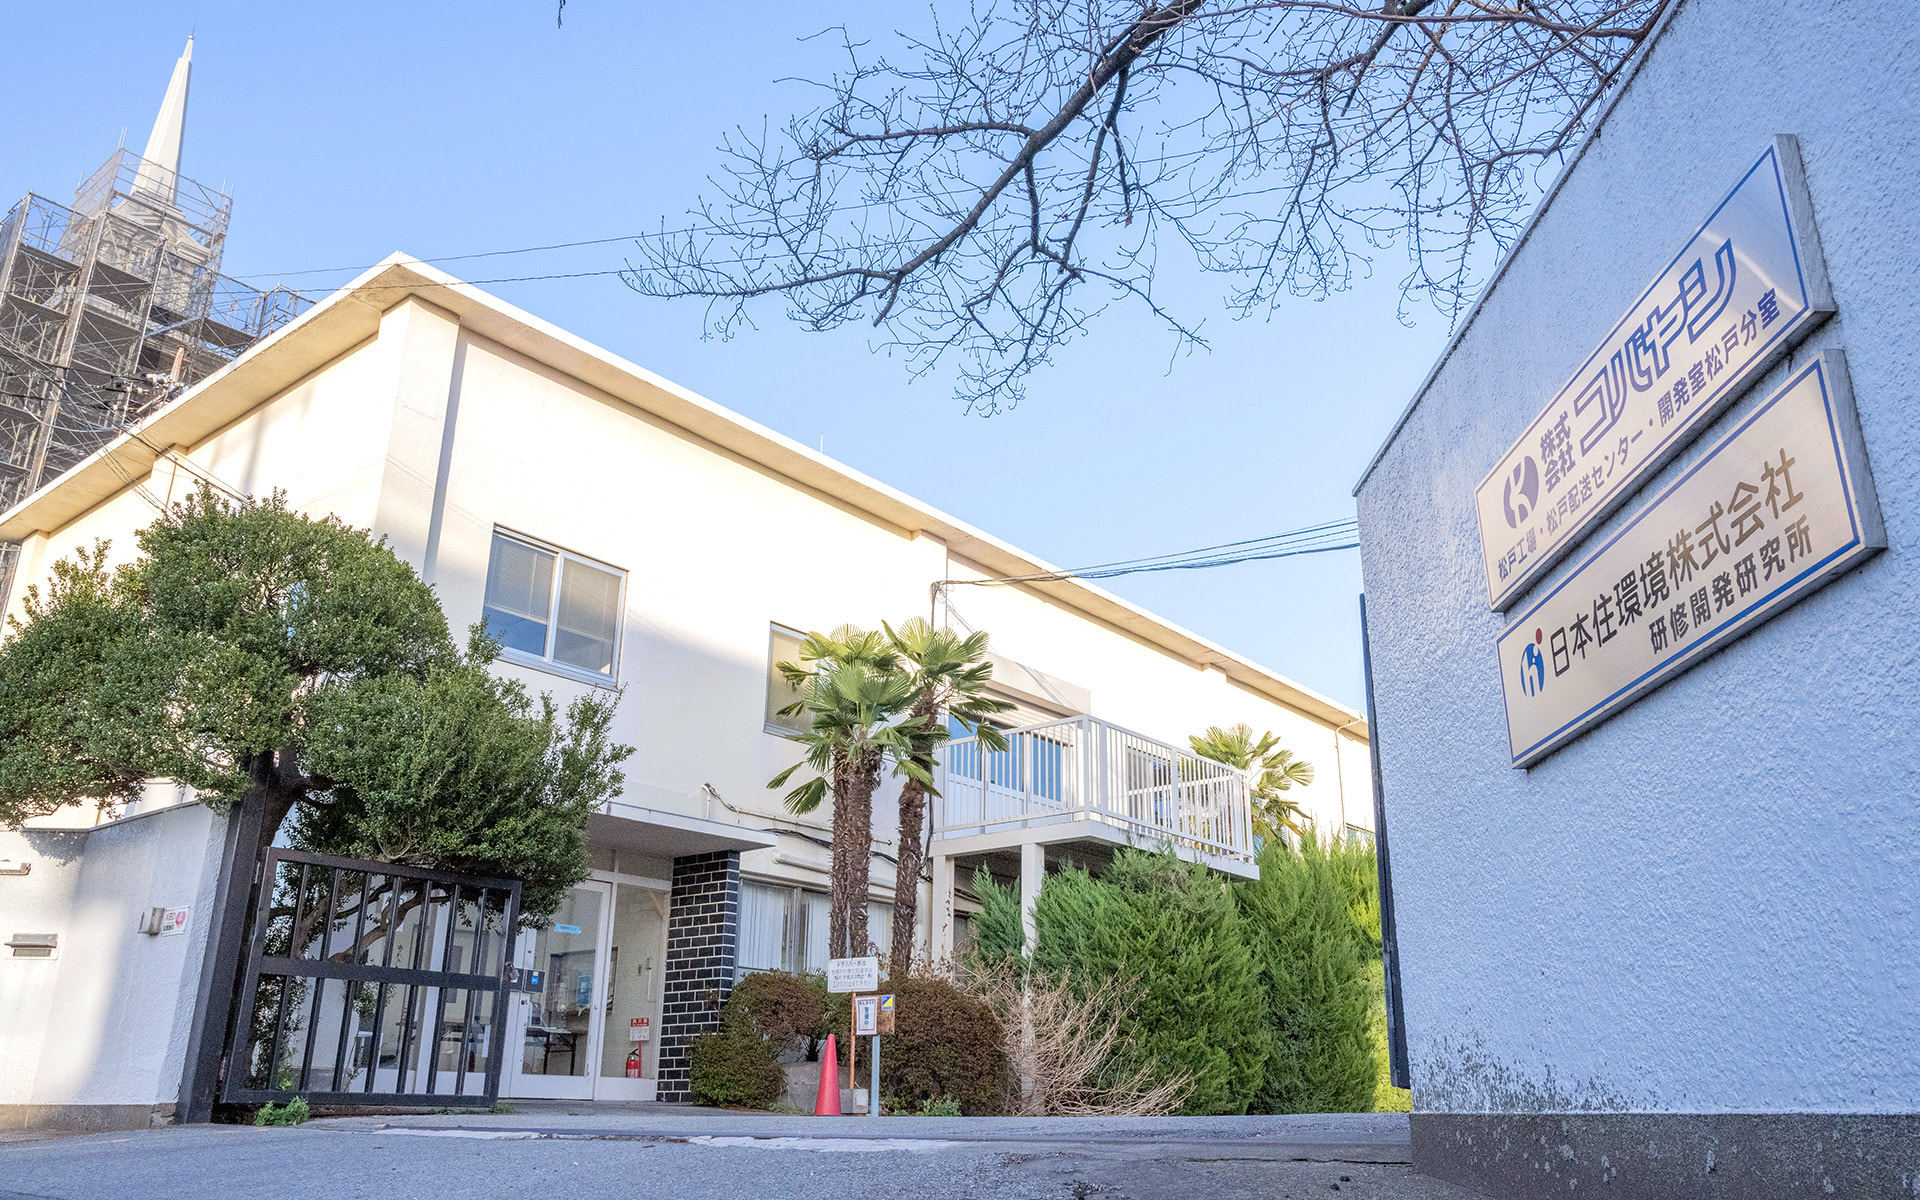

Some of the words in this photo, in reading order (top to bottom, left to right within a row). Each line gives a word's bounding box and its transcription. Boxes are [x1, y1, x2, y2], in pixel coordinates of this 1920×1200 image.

[1540, 411, 1571, 462] 株式
[1544, 444, 1577, 493] 会社
[1550, 448, 1804, 677] 日本住環境株式会社
[1649, 515, 1812, 655] 研修開発研究所
